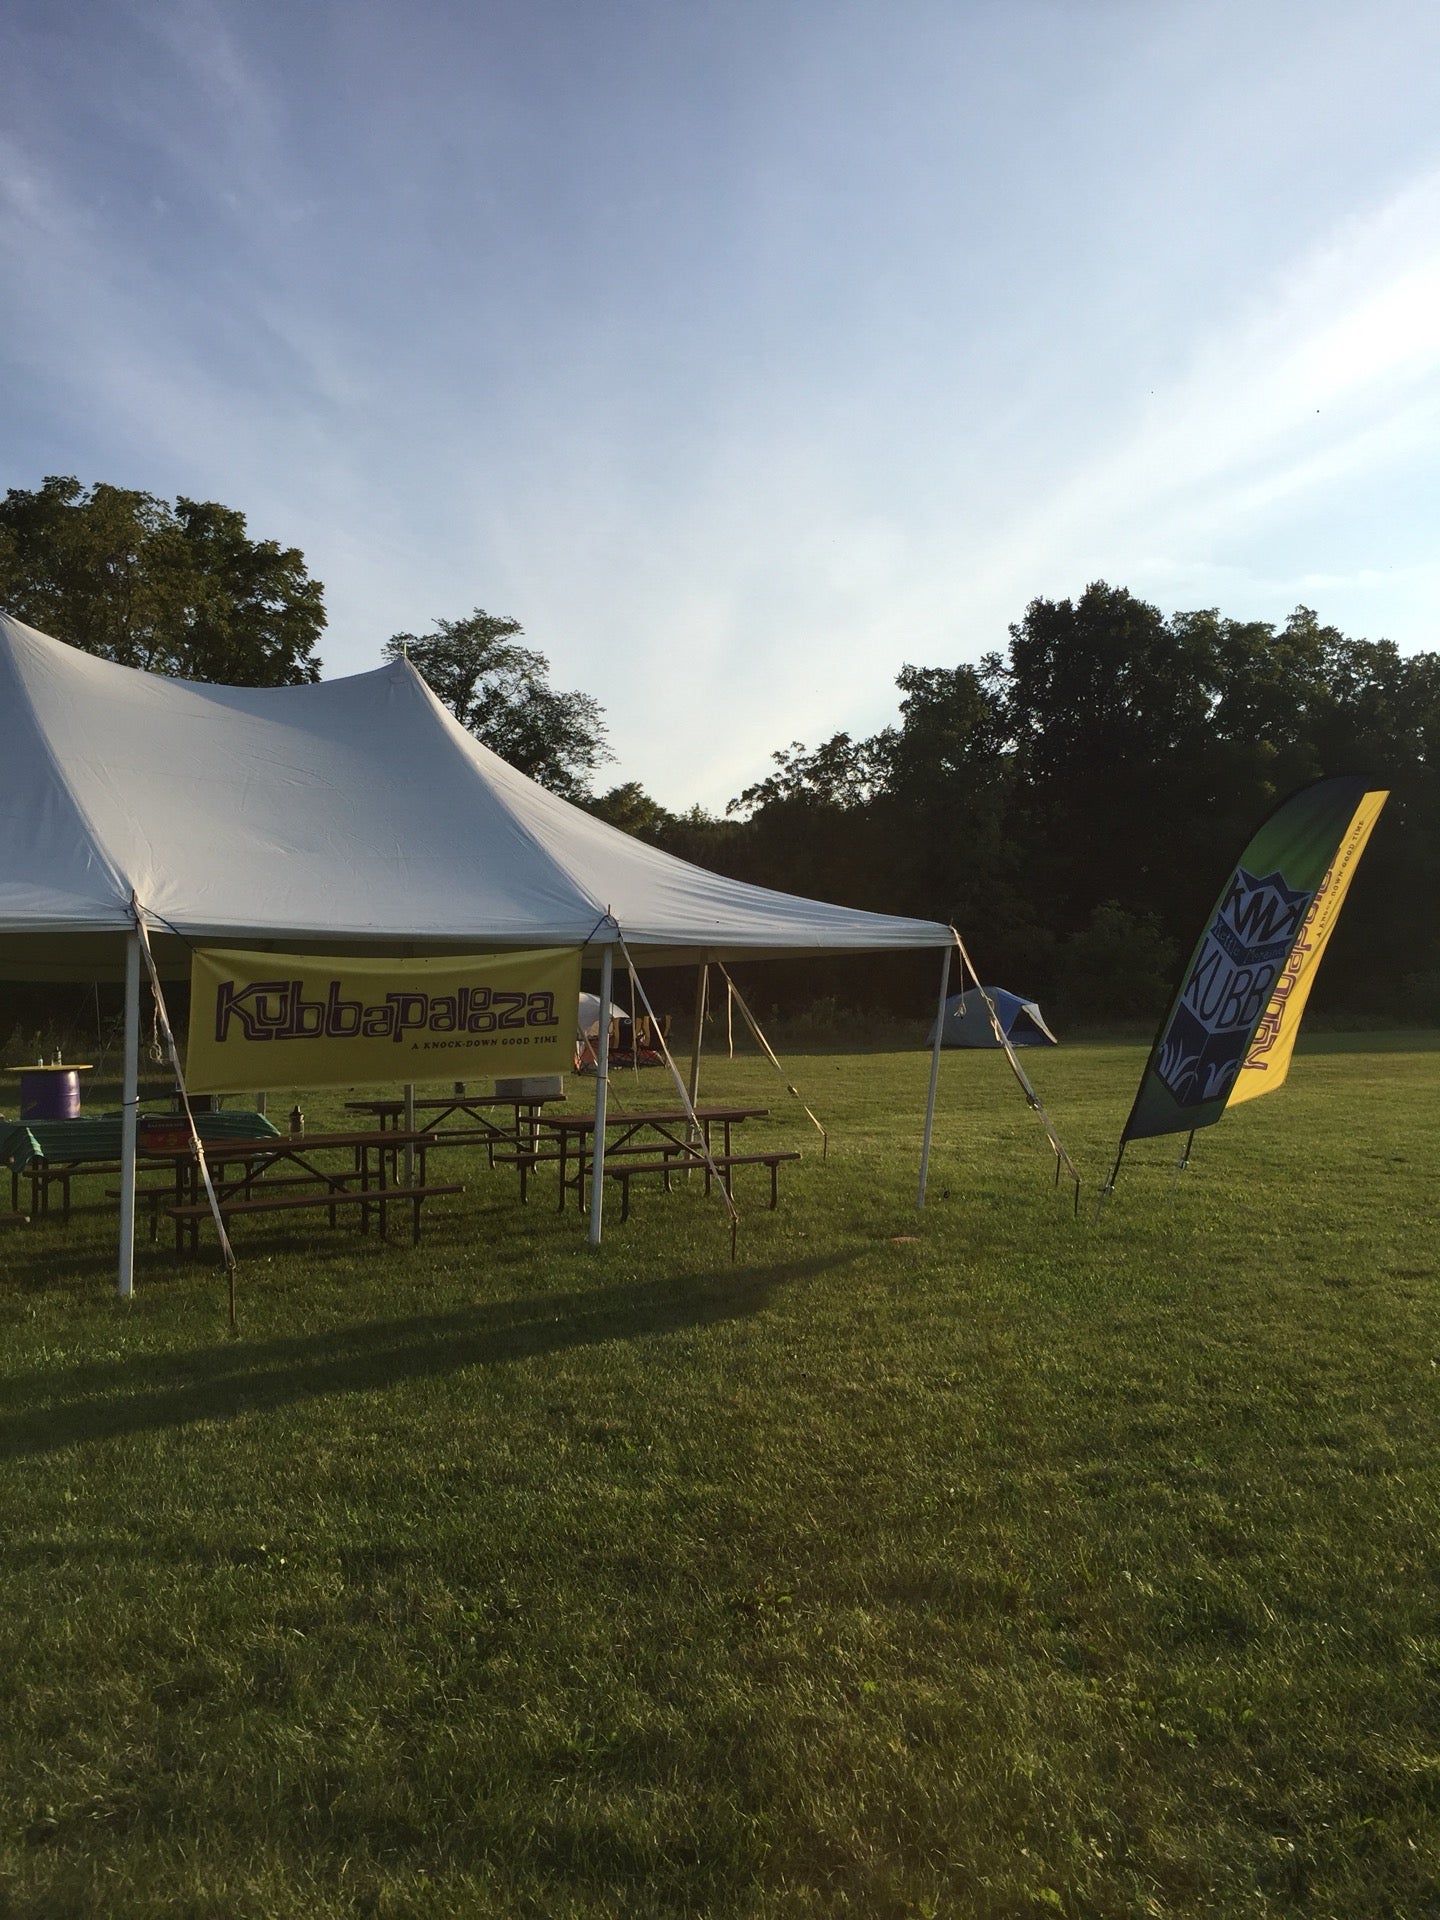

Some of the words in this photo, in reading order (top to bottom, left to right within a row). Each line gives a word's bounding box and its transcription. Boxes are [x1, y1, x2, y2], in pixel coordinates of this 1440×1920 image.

[1341, 843, 1355, 868] GOOD
[1352, 820, 1365, 841] TIME
[1184, 936, 1275, 1029] KUBB
[214, 980, 559, 1043] Kubbapalooza
[411, 1042, 419, 1050] A
[423, 1039, 498, 1050] KNOCK-DOWN
[502, 1036, 530, 1046] GOOD
[534, 1035, 559, 1045] TIME
